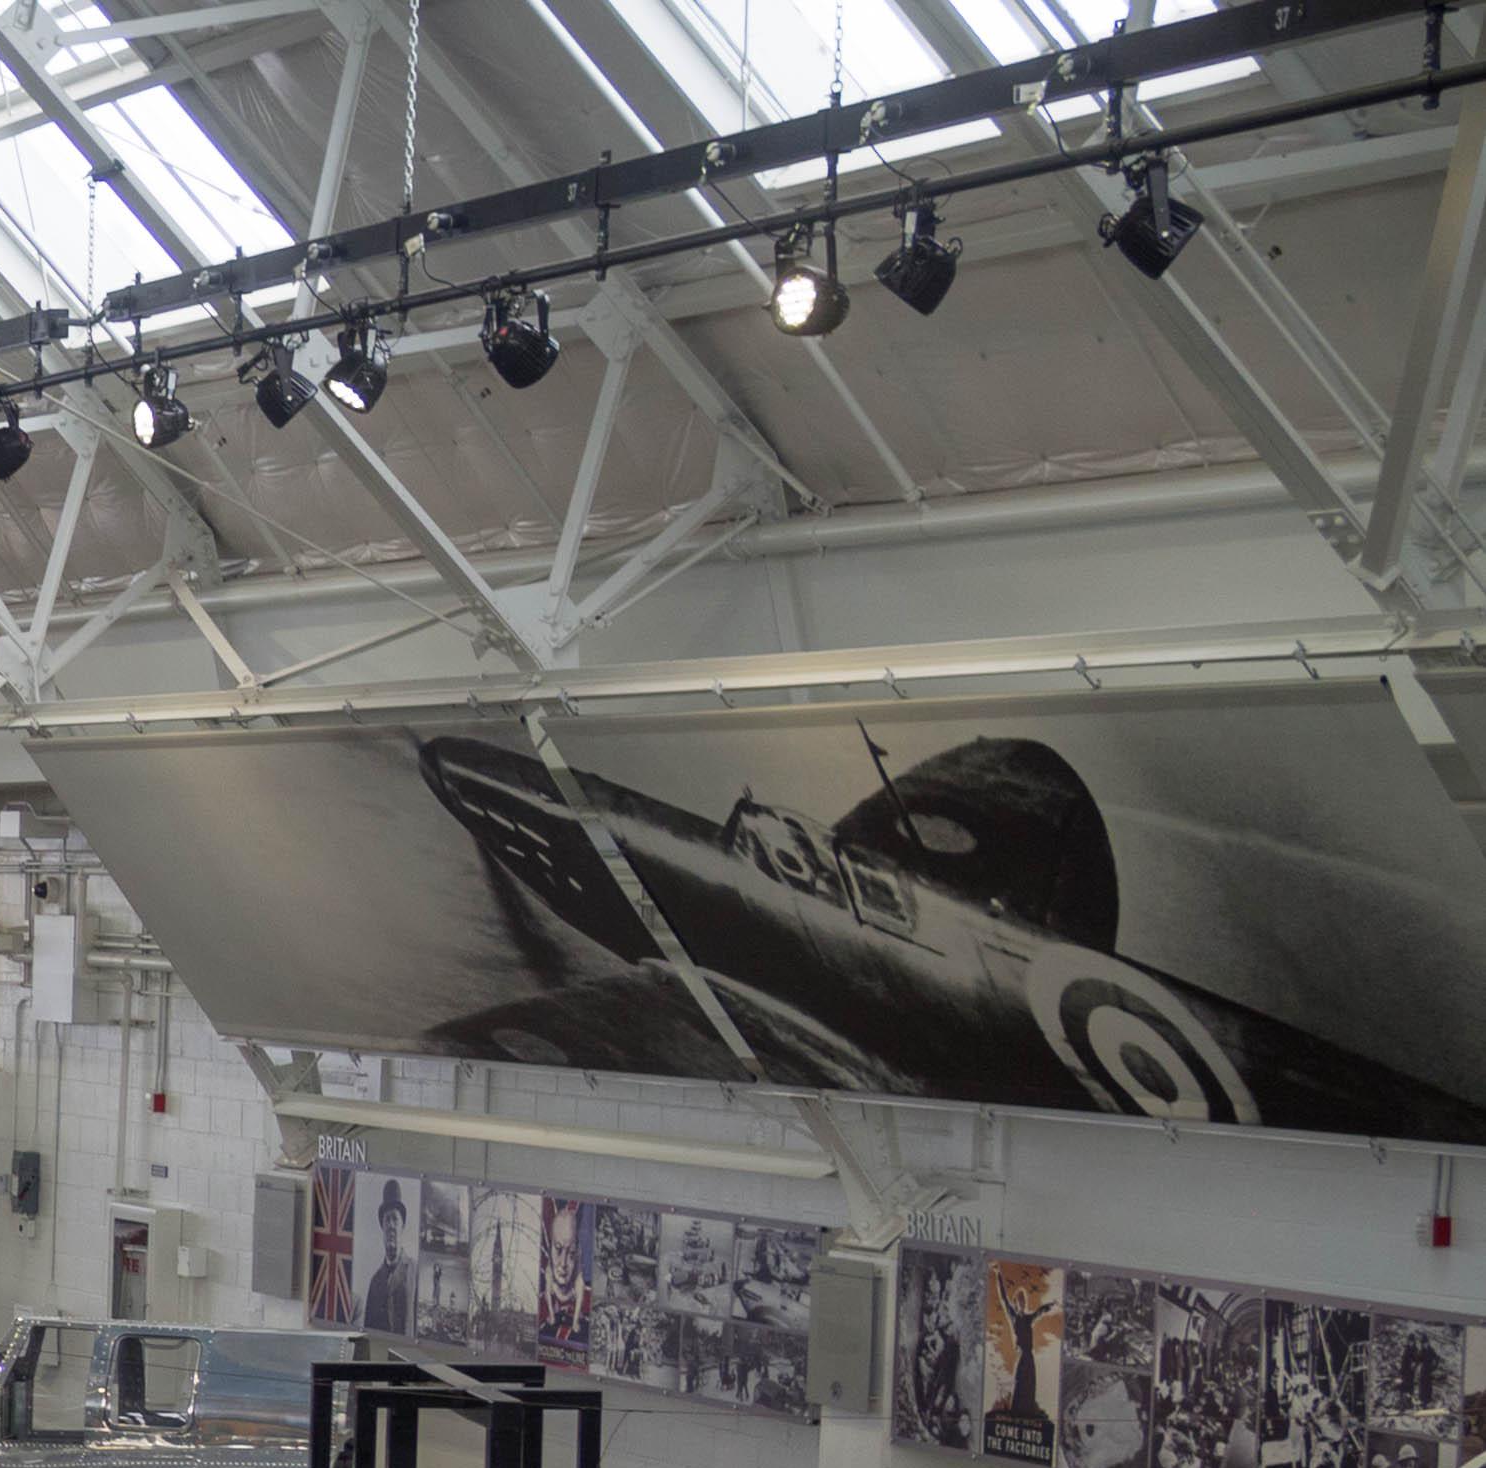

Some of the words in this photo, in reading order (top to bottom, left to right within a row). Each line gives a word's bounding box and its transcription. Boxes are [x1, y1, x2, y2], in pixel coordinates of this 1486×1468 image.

[317, 1134, 367, 1163] BRITAIN
[905, 1208, 982, 1248] BRITAIN
[995, 1423, 1020, 1440] COME
[1022, 1429, 1043, 1444] INTO
[987, 1435, 1002, 1450] THE
[1005, 1440, 1051, 1460] FACTORIES
